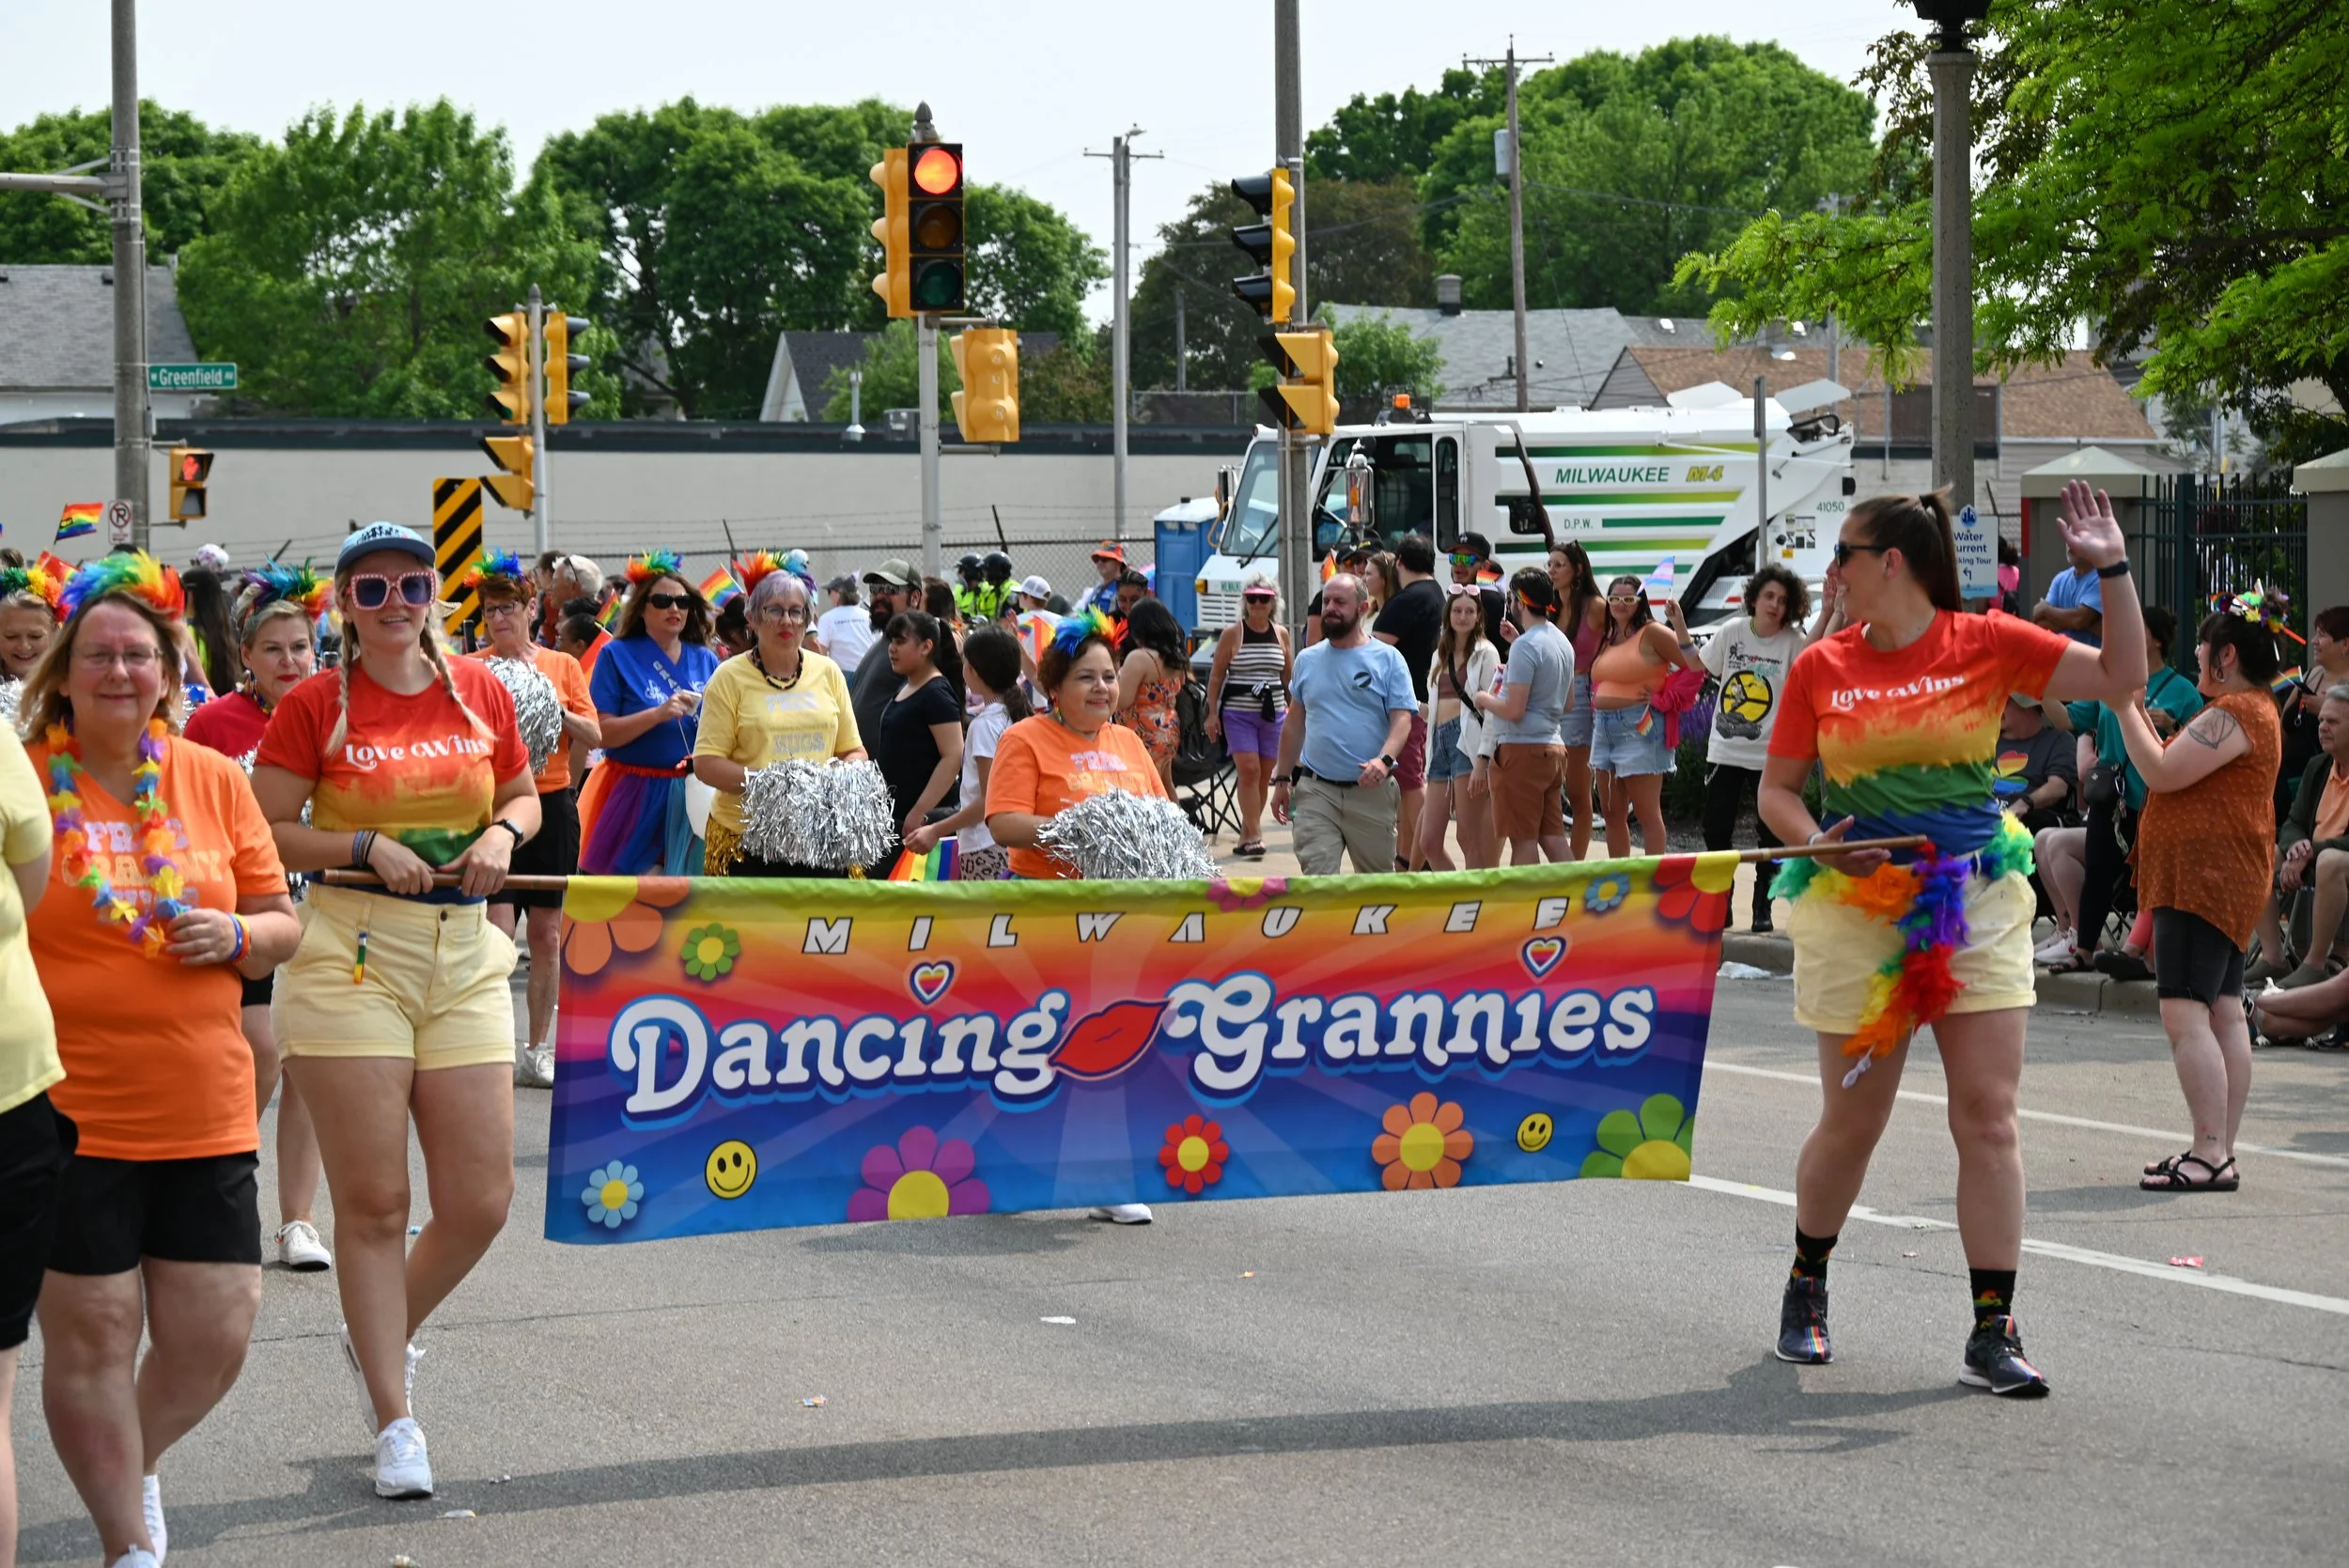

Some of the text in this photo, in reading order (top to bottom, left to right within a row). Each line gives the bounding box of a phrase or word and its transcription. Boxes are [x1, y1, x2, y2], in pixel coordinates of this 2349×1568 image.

[159, 367, 223, 386] Greenfield
[1555, 467, 1671, 484] MILWAUKEE
[1816, 501, 1845, 512] 41050
[1563, 518, 1594, 530] D.P.W.
[1953, 532, 1983, 542] Water
[1955, 544, 1987, 553] urrent
[1958, 556, 1974, 566] king
[801, 896, 1571, 955] MILWAUKEE
[609, 970, 1656, 1116] Dancing Grannies
